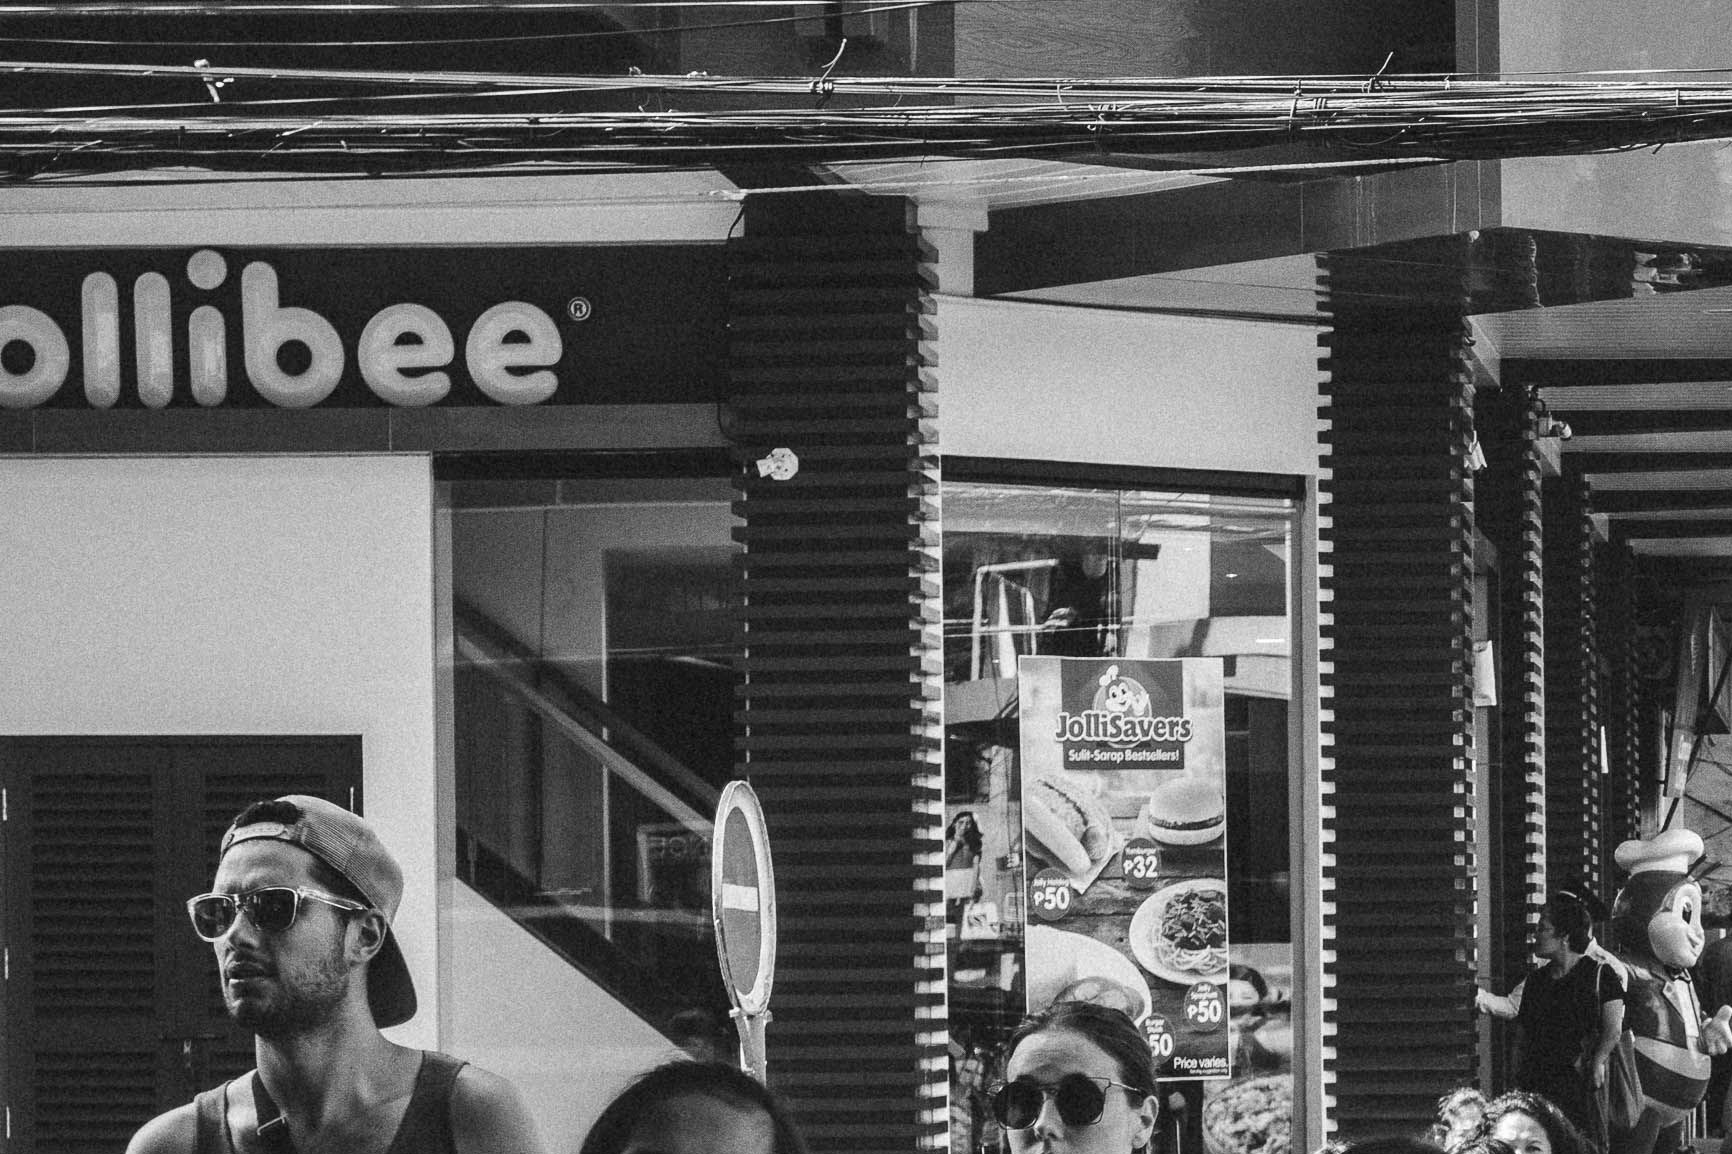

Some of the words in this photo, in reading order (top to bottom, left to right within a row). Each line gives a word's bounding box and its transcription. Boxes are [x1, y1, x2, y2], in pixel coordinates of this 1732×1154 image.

[0, 249, 564, 409] ollibee
[1055, 710, 1193, 741] JolliSavers
[1068, 749, 1125, 764] Sulit-Sarap
[1124, 749, 1180, 762] Bestsellers!
[1173, 1056, 1198, 1069] Price
